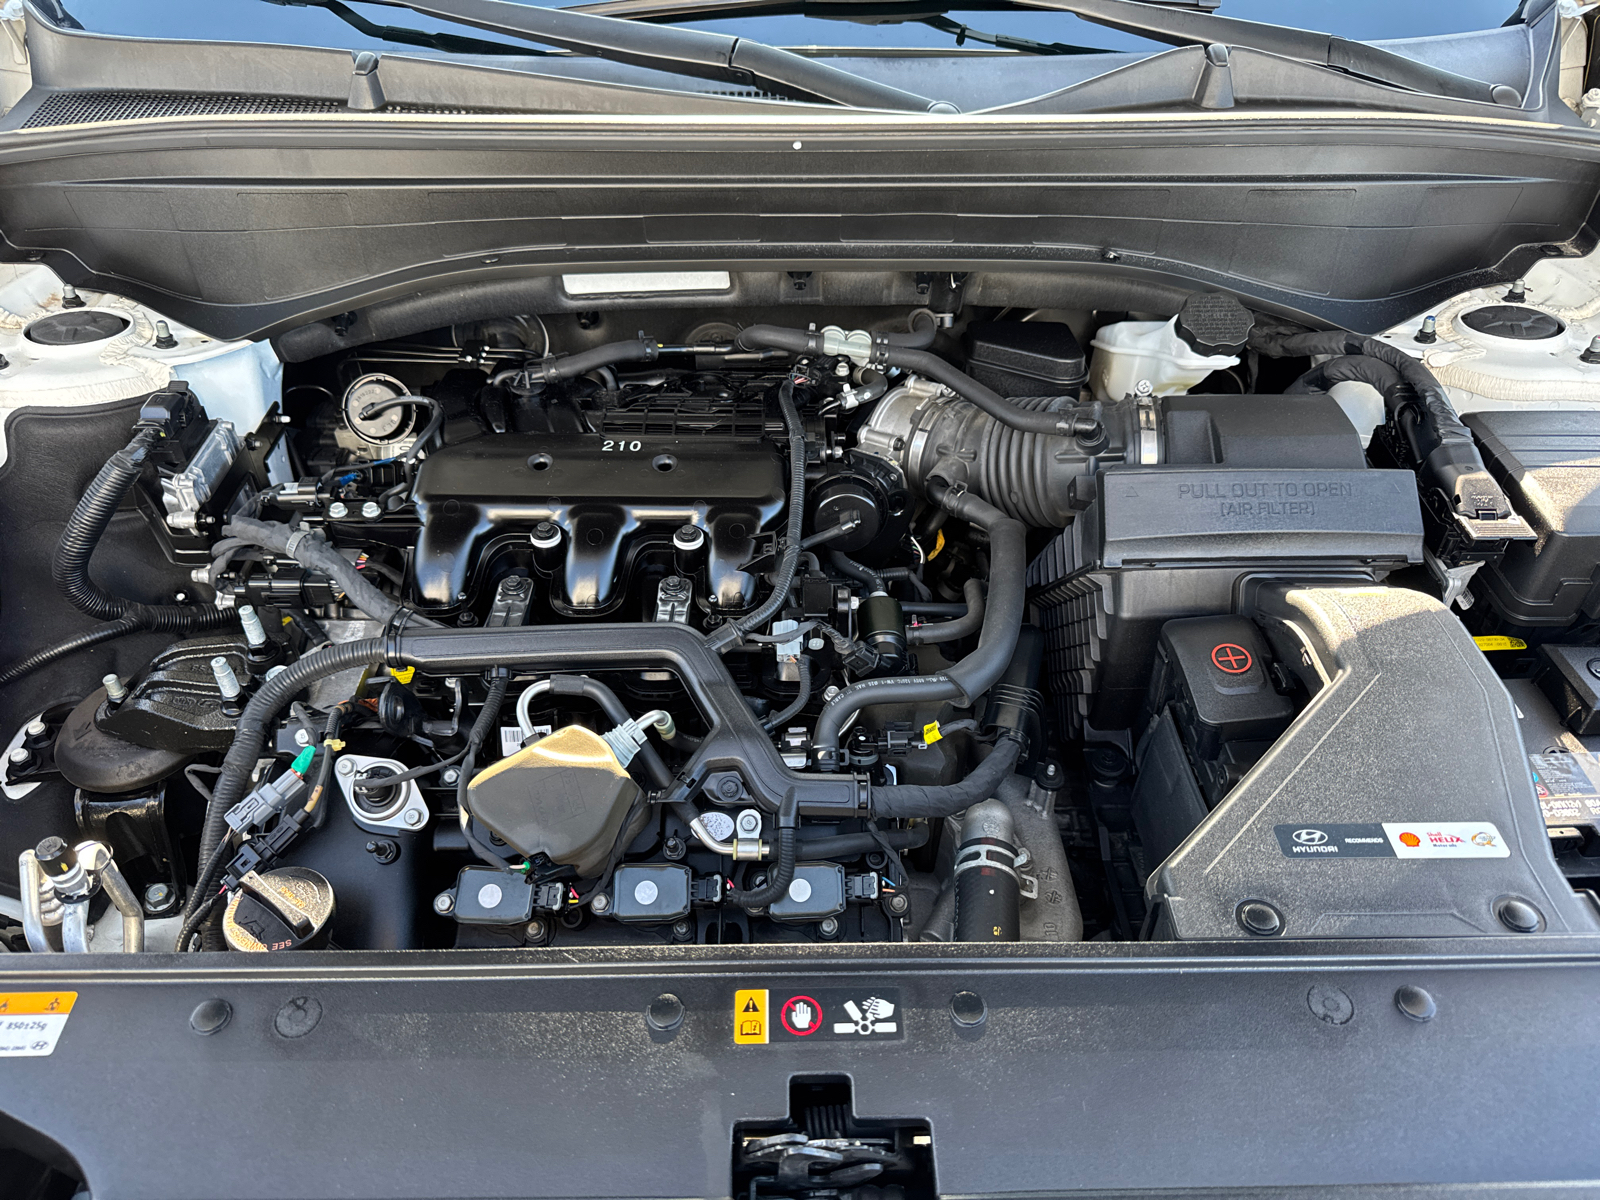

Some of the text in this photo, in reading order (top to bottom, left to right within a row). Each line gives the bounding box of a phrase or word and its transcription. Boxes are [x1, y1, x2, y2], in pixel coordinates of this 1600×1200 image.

[601, 440, 642, 452] 210
[1178, 481, 1352, 499] PULL OUT TO OPEN
[1292, 837, 1384, 853] HYUNDAI RECOMMENDS
[271, 939, 292, 951] SEE
